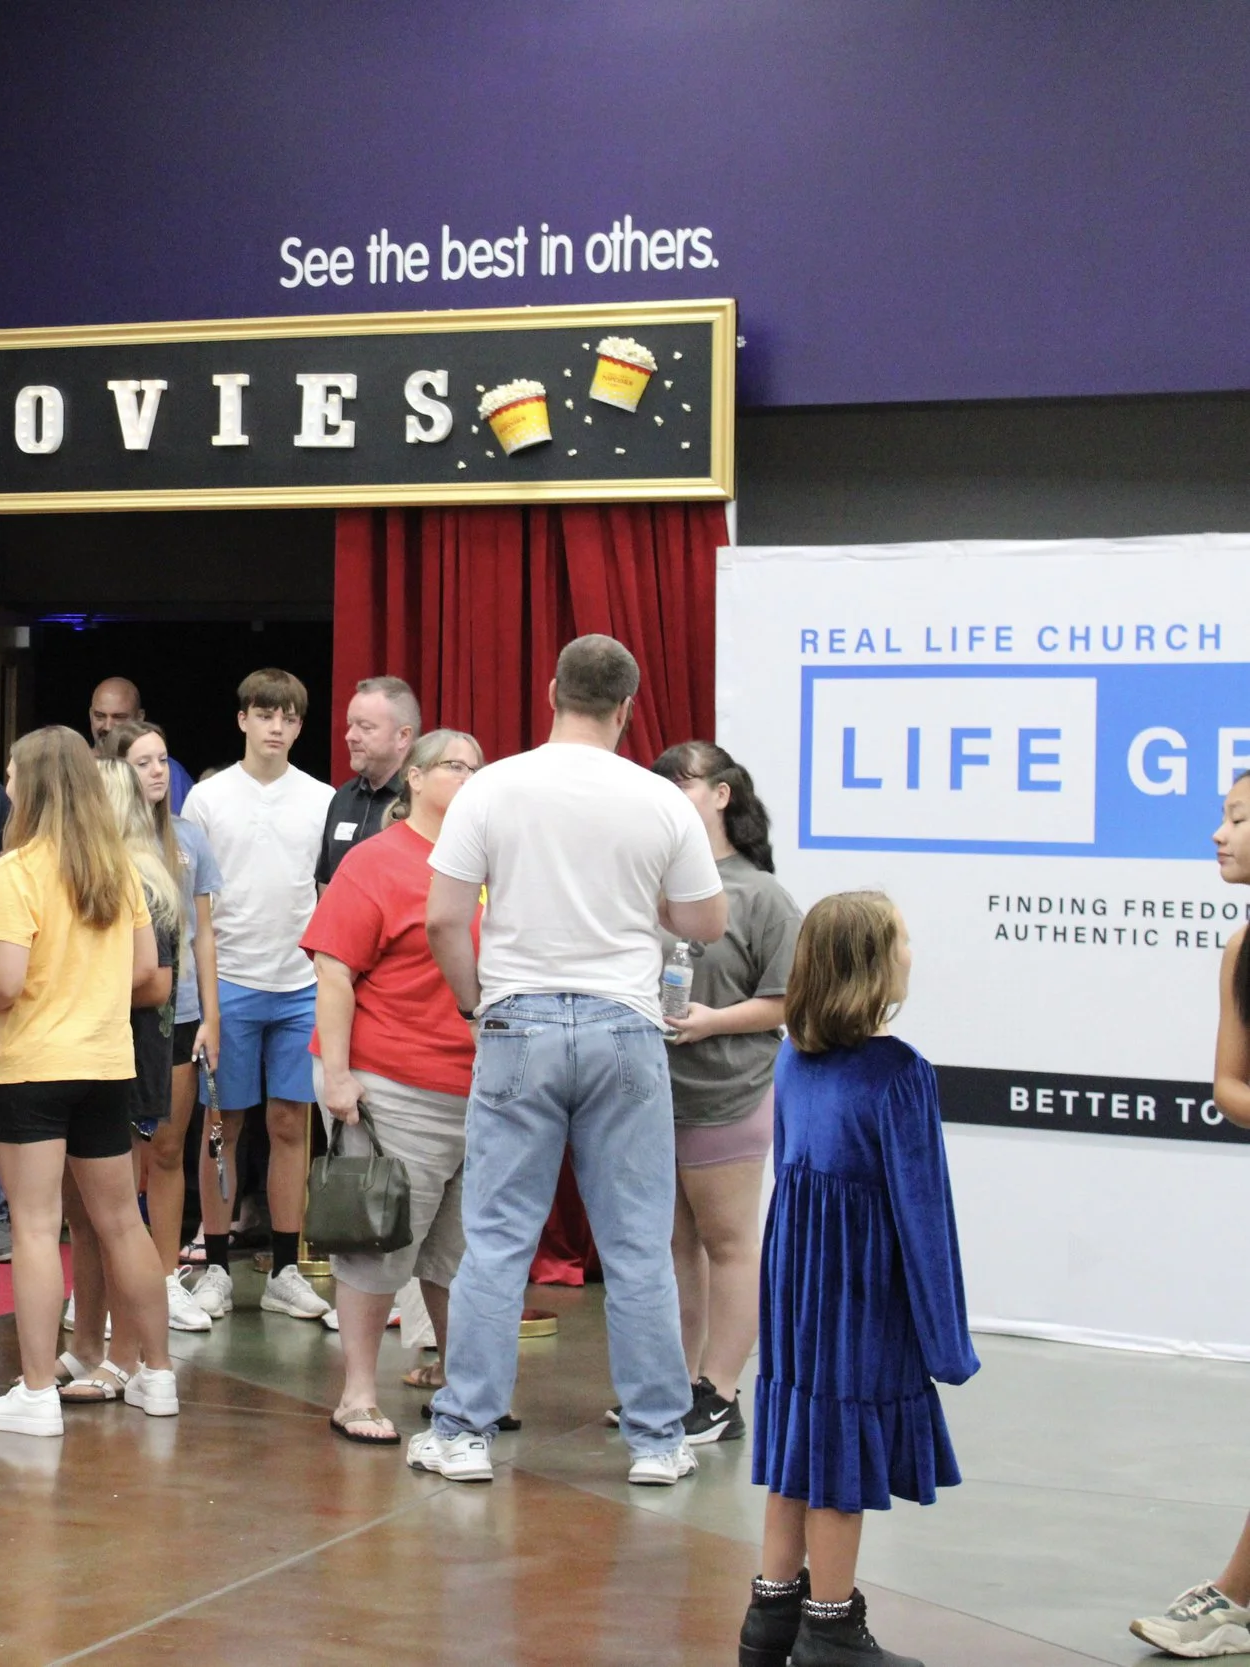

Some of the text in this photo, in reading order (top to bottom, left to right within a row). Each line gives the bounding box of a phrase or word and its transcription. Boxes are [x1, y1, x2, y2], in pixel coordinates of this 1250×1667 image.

[280, 214, 720, 288] See the best in others.
[800, 623, 1222, 654] REAL LIFE CHURCH
[842, 727, 1063, 792] LIFE
[988, 895, 1250, 921] FINDING FREEDO
[995, 923, 1159, 947] AUTHENTIC
[1009, 1086, 1157, 1122] BETTER
